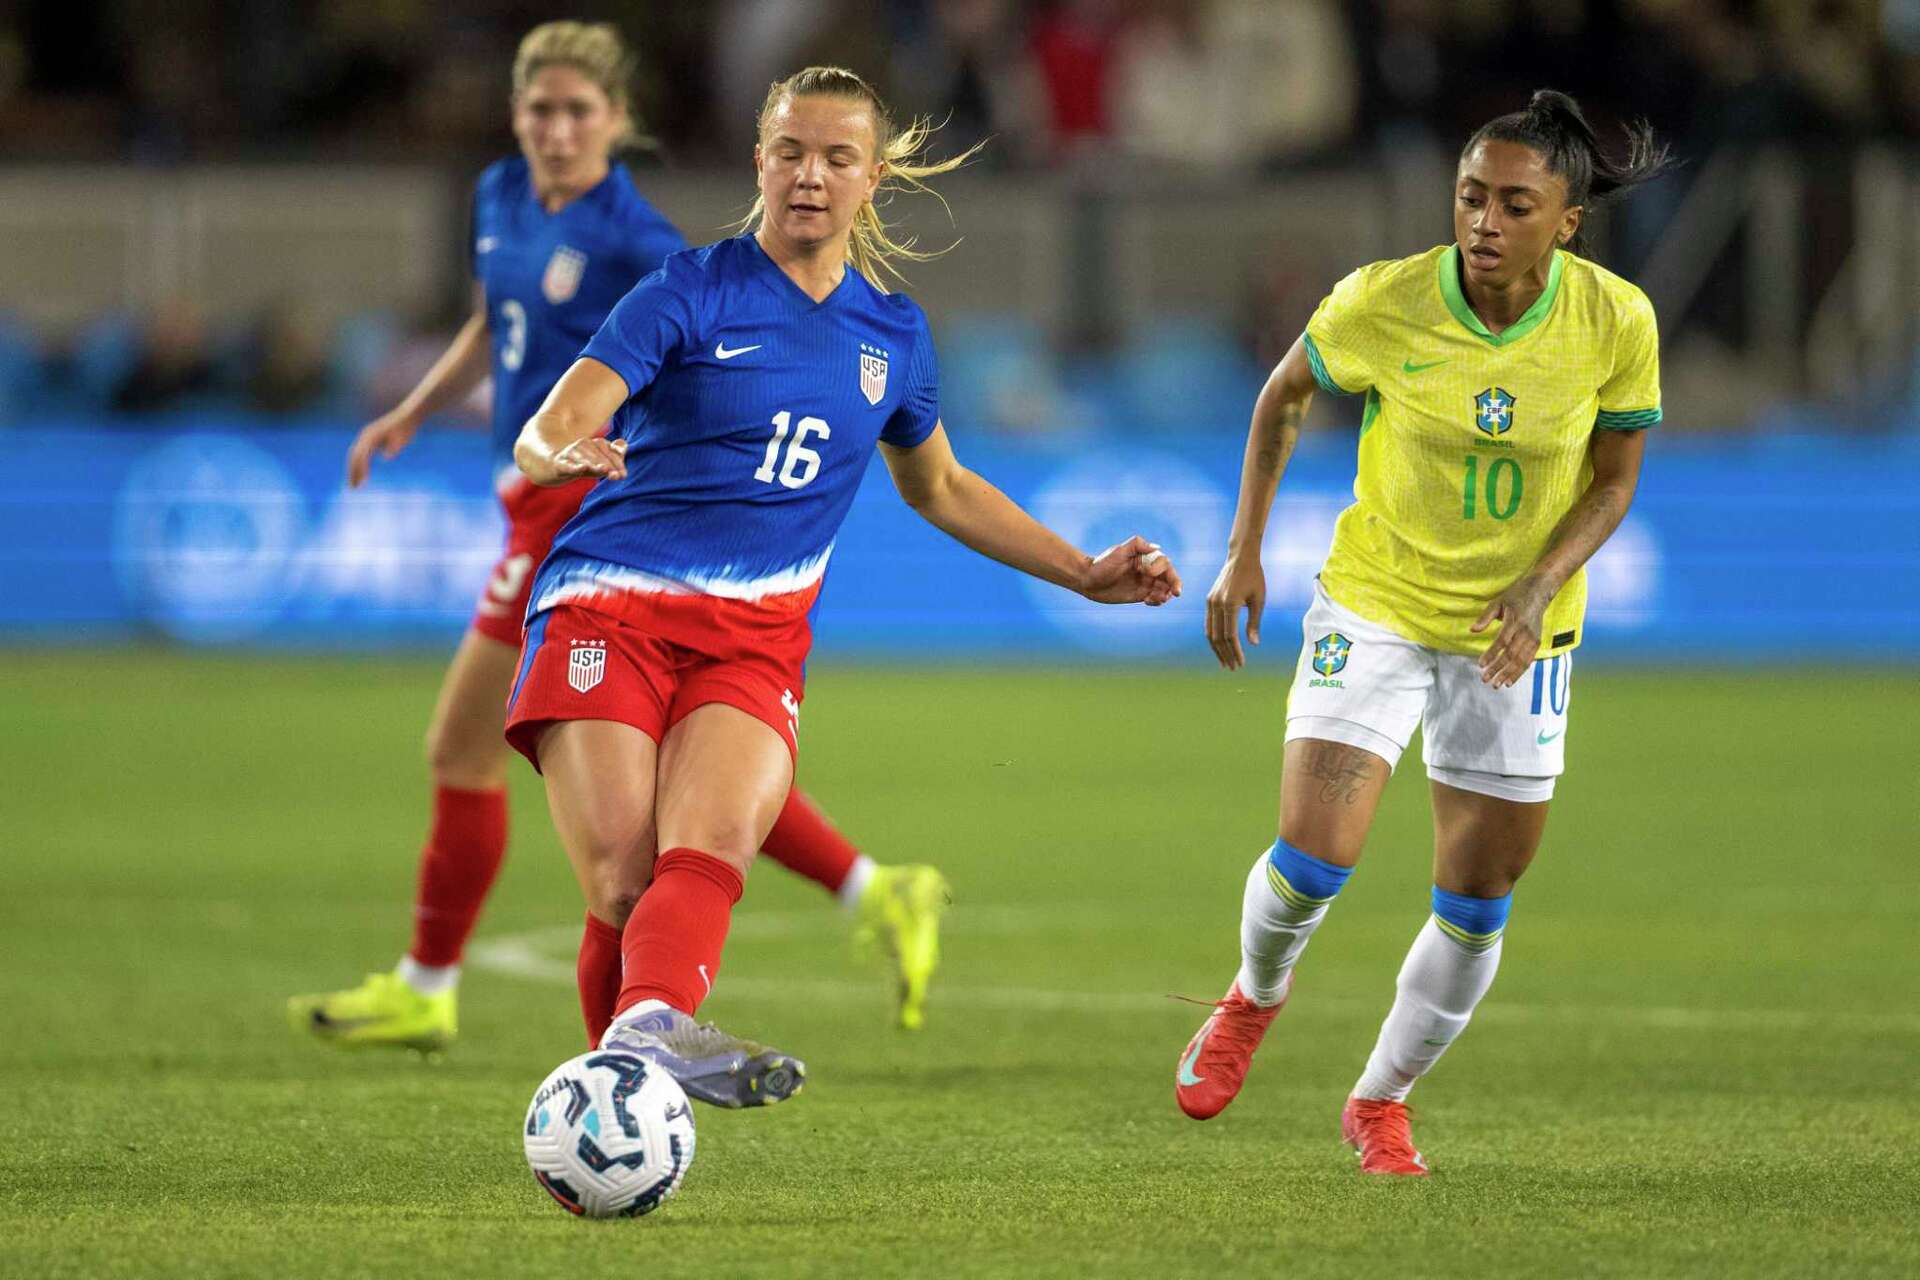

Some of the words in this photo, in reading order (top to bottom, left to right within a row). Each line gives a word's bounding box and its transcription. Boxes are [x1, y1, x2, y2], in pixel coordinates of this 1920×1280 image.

[502, 299, 527, 372] 3
[862, 356, 886, 377] USA
[754, 410, 831, 489] 16
[1474, 438, 1516, 449] BRASIL
[1463, 455, 1523, 520] 10
[572, 650, 604, 667] USA
[1309, 678, 1346, 689] BRASIL
[1531, 652, 1567, 716] 10
